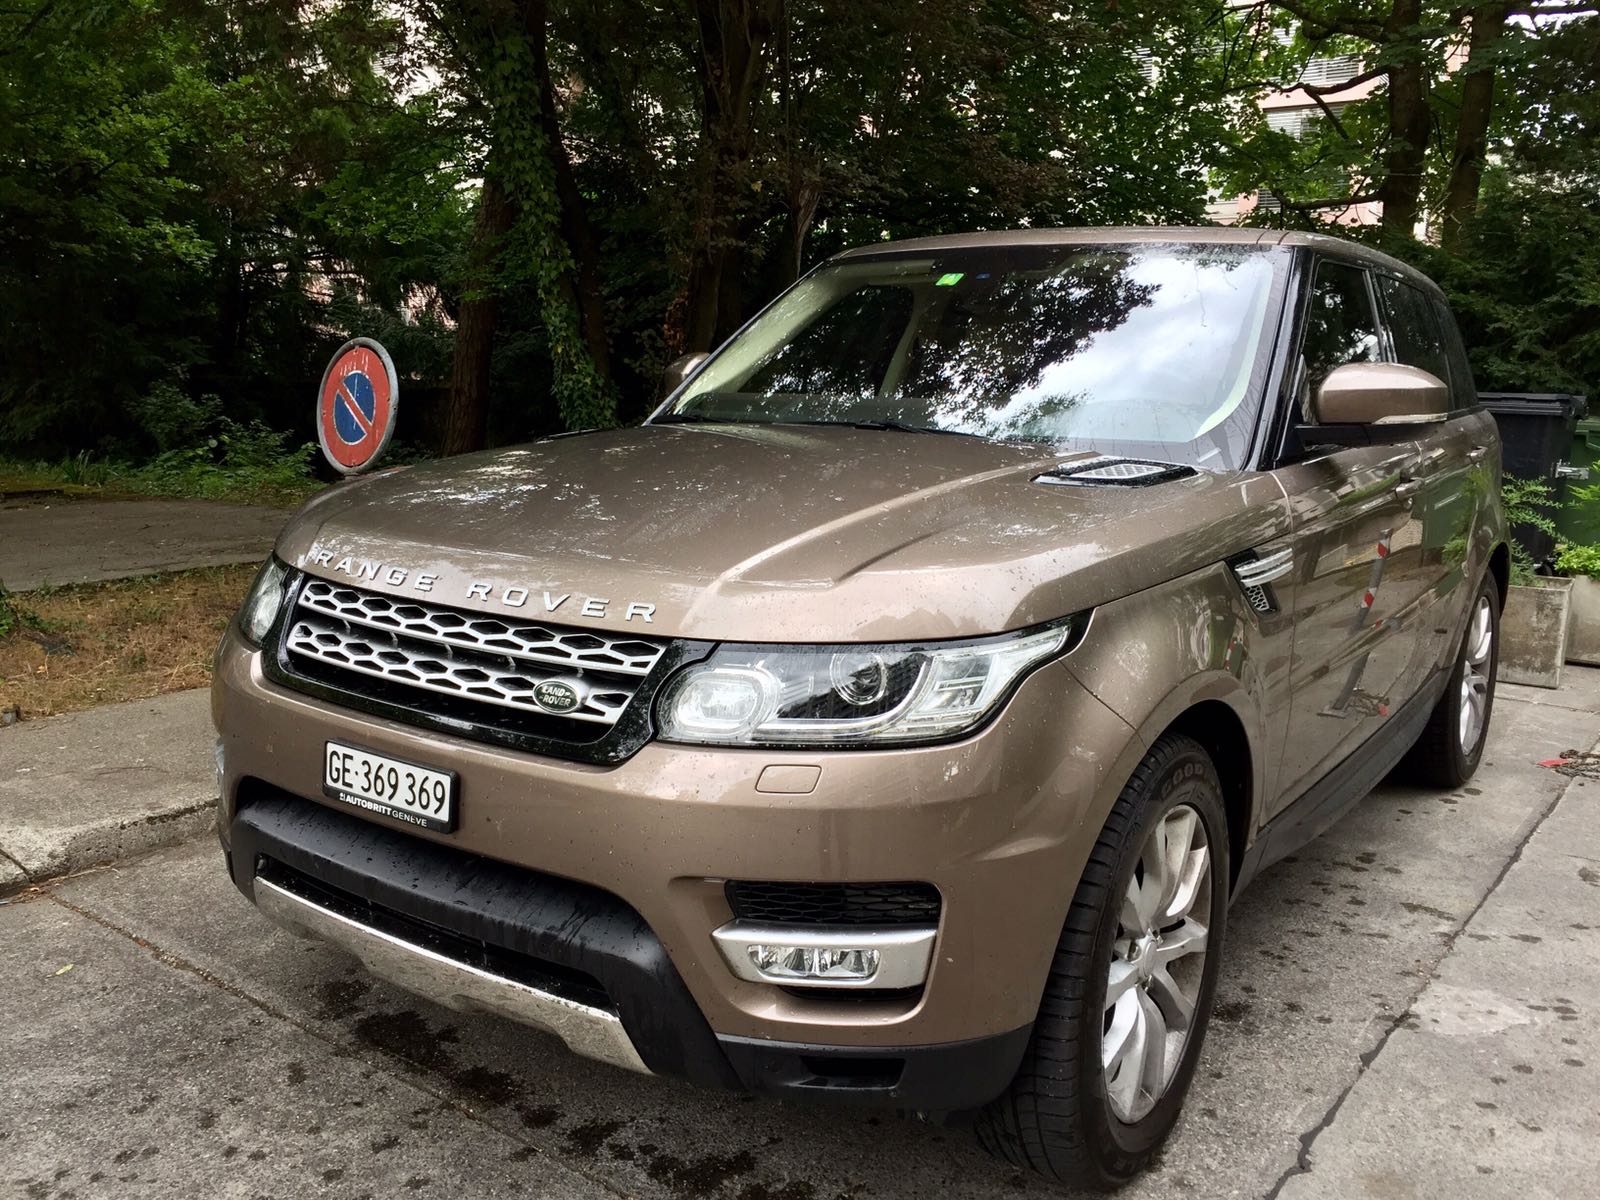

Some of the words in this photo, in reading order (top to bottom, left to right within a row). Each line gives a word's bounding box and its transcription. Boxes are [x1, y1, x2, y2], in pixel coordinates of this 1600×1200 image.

[314, 549, 439, 593] RANGE
[466, 581, 657, 623] ROVER
[542, 694, 571, 707] ROVER
[345, 794, 391, 815] AUTOBRITT
